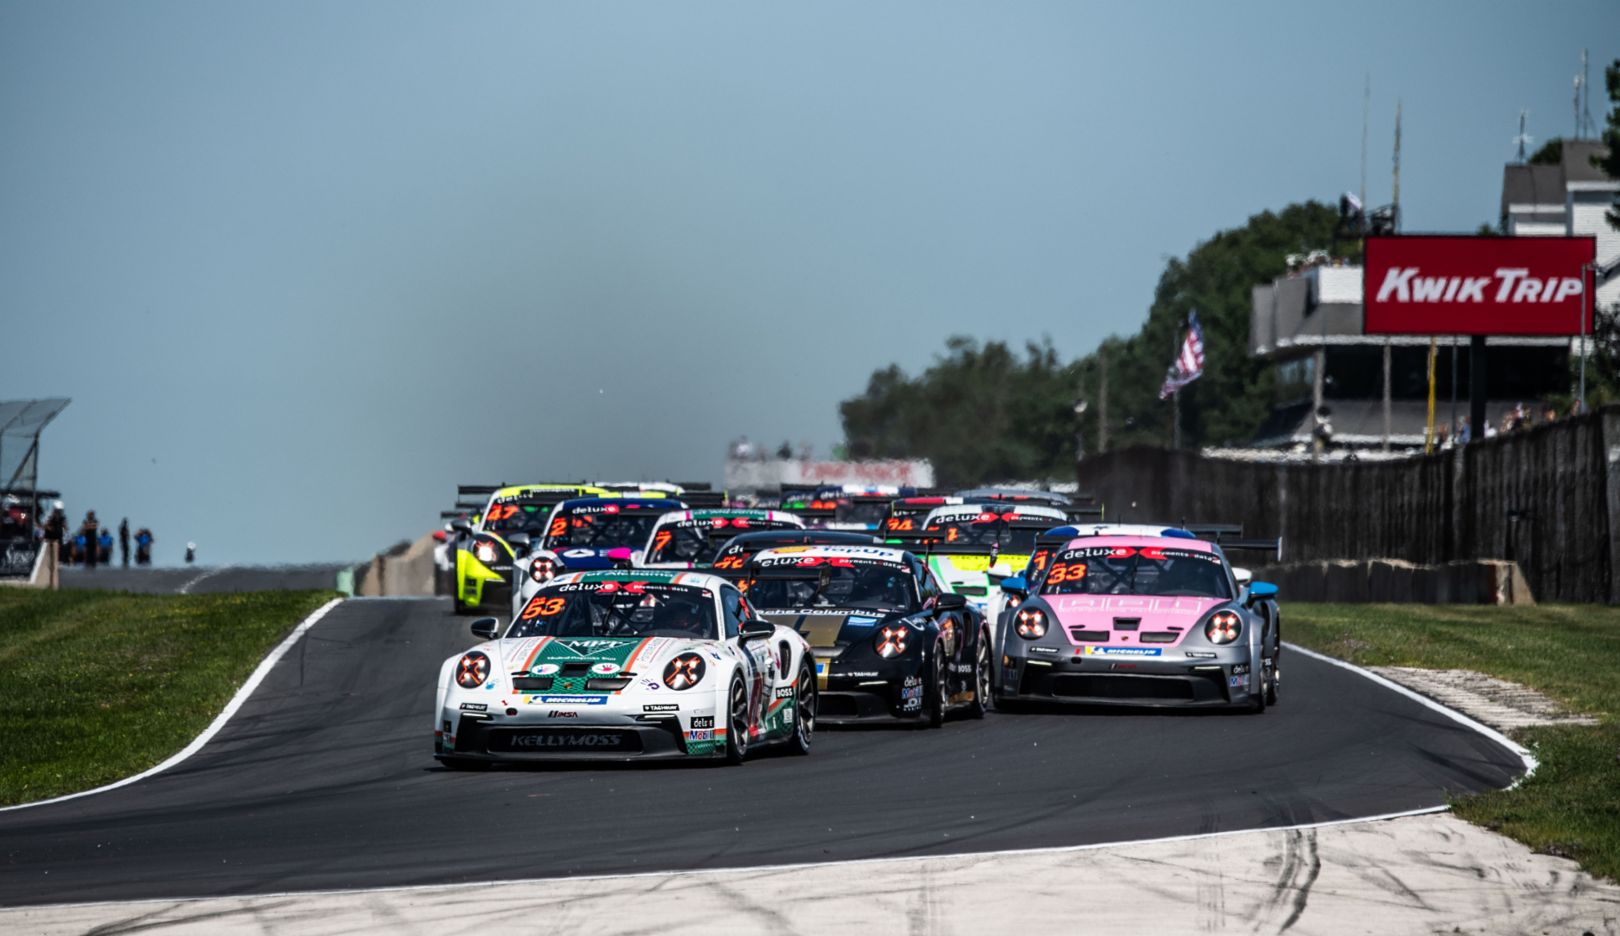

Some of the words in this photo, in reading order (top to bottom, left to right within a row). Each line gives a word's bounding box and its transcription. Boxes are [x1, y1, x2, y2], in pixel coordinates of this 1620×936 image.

[1494, 266, 1584, 303] TRIP
[572, 505, 616, 515] deluxe
[677, 519, 723, 528] deluxe
[935, 512, 990, 525] deluxe
[655, 533, 673, 551] 7
[1064, 547, 1127, 560] deluxe
[758, 555, 815, 568] eluxe
[1047, 562, 1087, 585] 33
[559, 582, 615, 593] deluxe
[522, 597, 566, 620] 53
[800, 608, 887, 618] Columbus
[545, 696, 602, 704] MICHELIN
